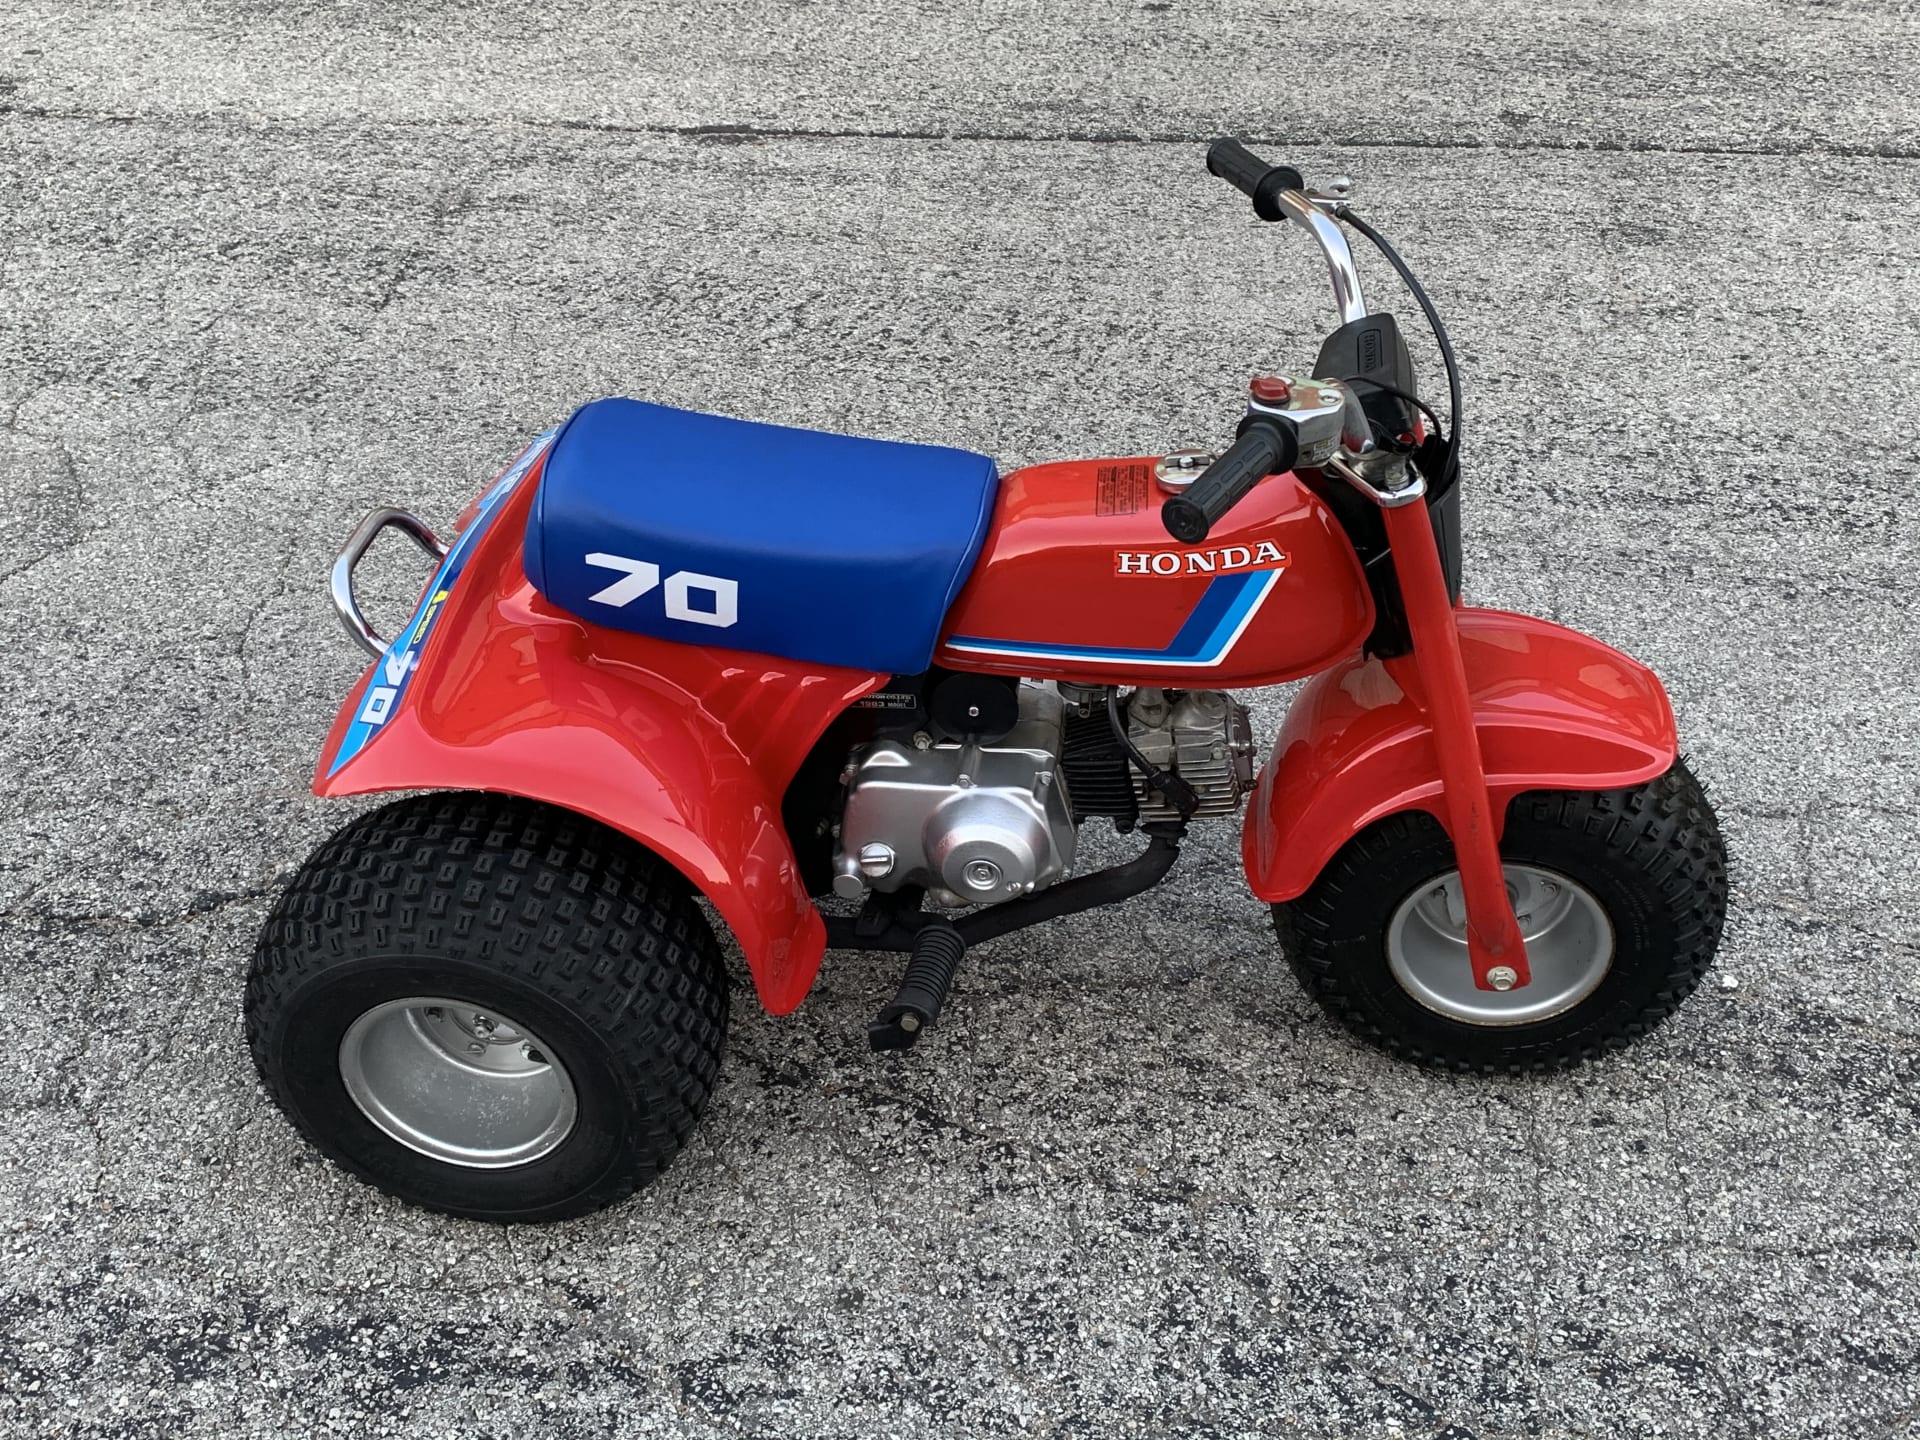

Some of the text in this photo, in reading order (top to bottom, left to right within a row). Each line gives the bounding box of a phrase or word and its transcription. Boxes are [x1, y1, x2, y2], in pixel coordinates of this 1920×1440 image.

[585, 552, 739, 628] 70
[1117, 541, 1287, 576] HONDA
[359, 650, 415, 725] 70
